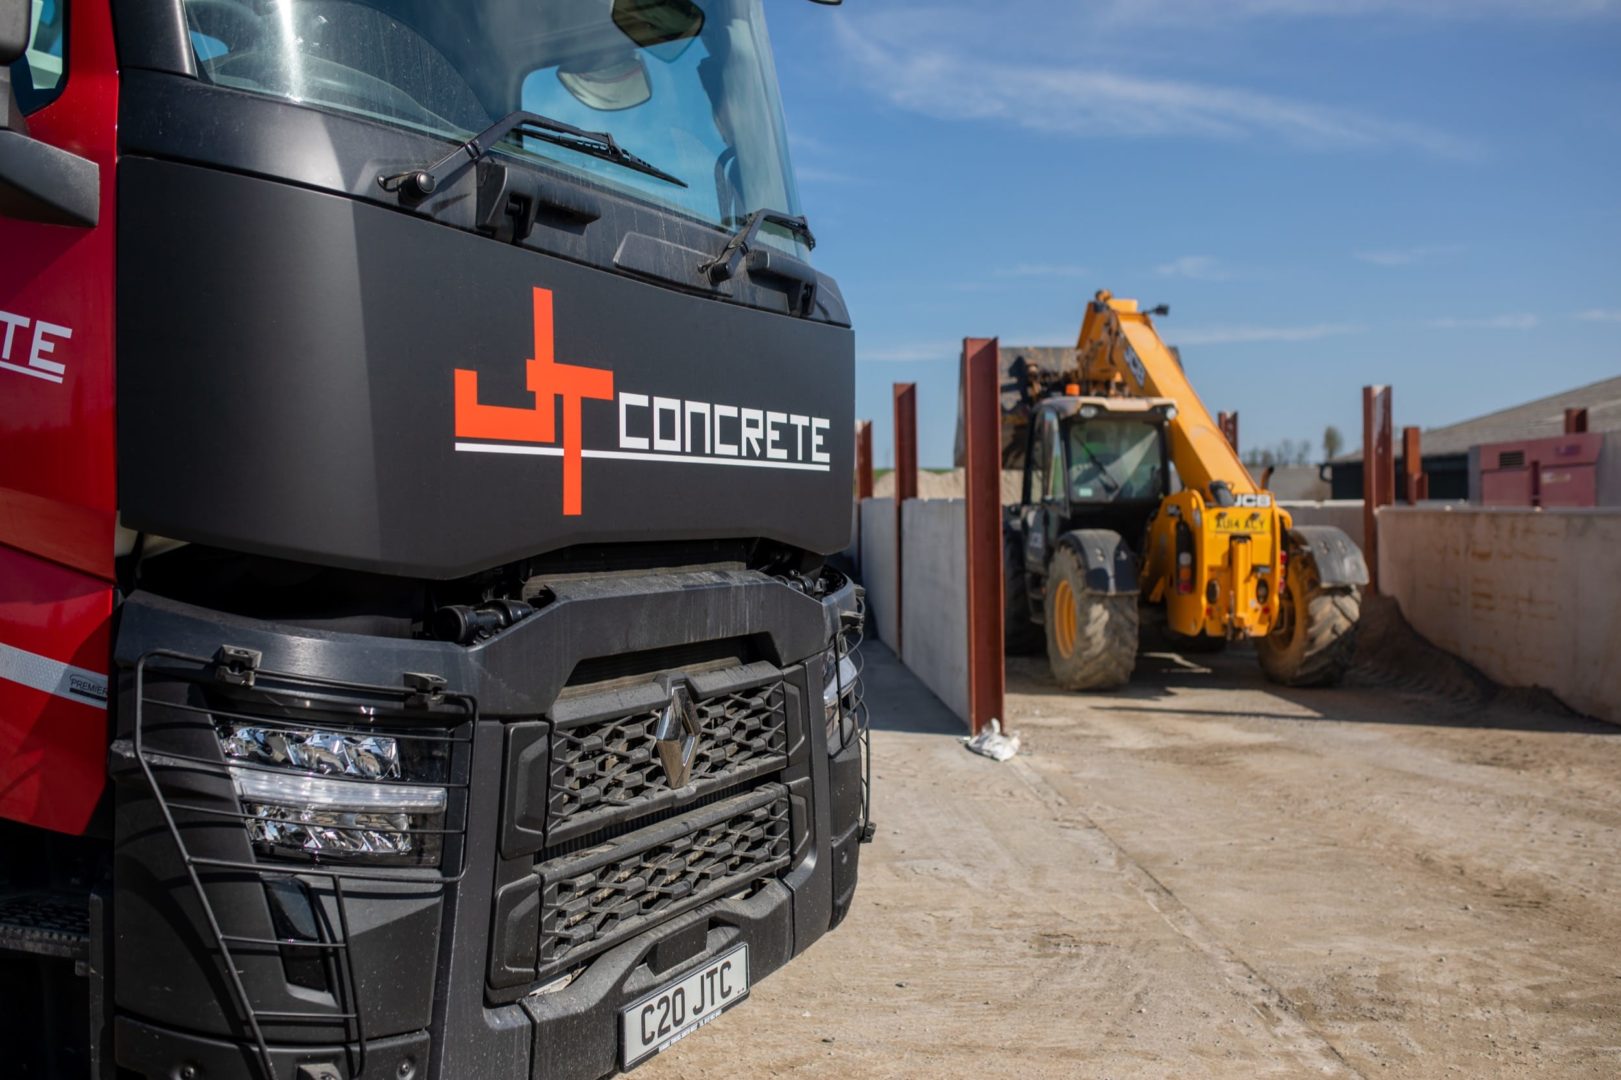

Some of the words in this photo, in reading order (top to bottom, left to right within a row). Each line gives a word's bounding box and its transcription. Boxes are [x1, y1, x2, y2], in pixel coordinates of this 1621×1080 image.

[619, 391, 831, 463] CONCRETE
[1234, 493, 1271, 507] JCB
[641, 986, 685, 1046] C20
[692, 960, 732, 1016] JTC
